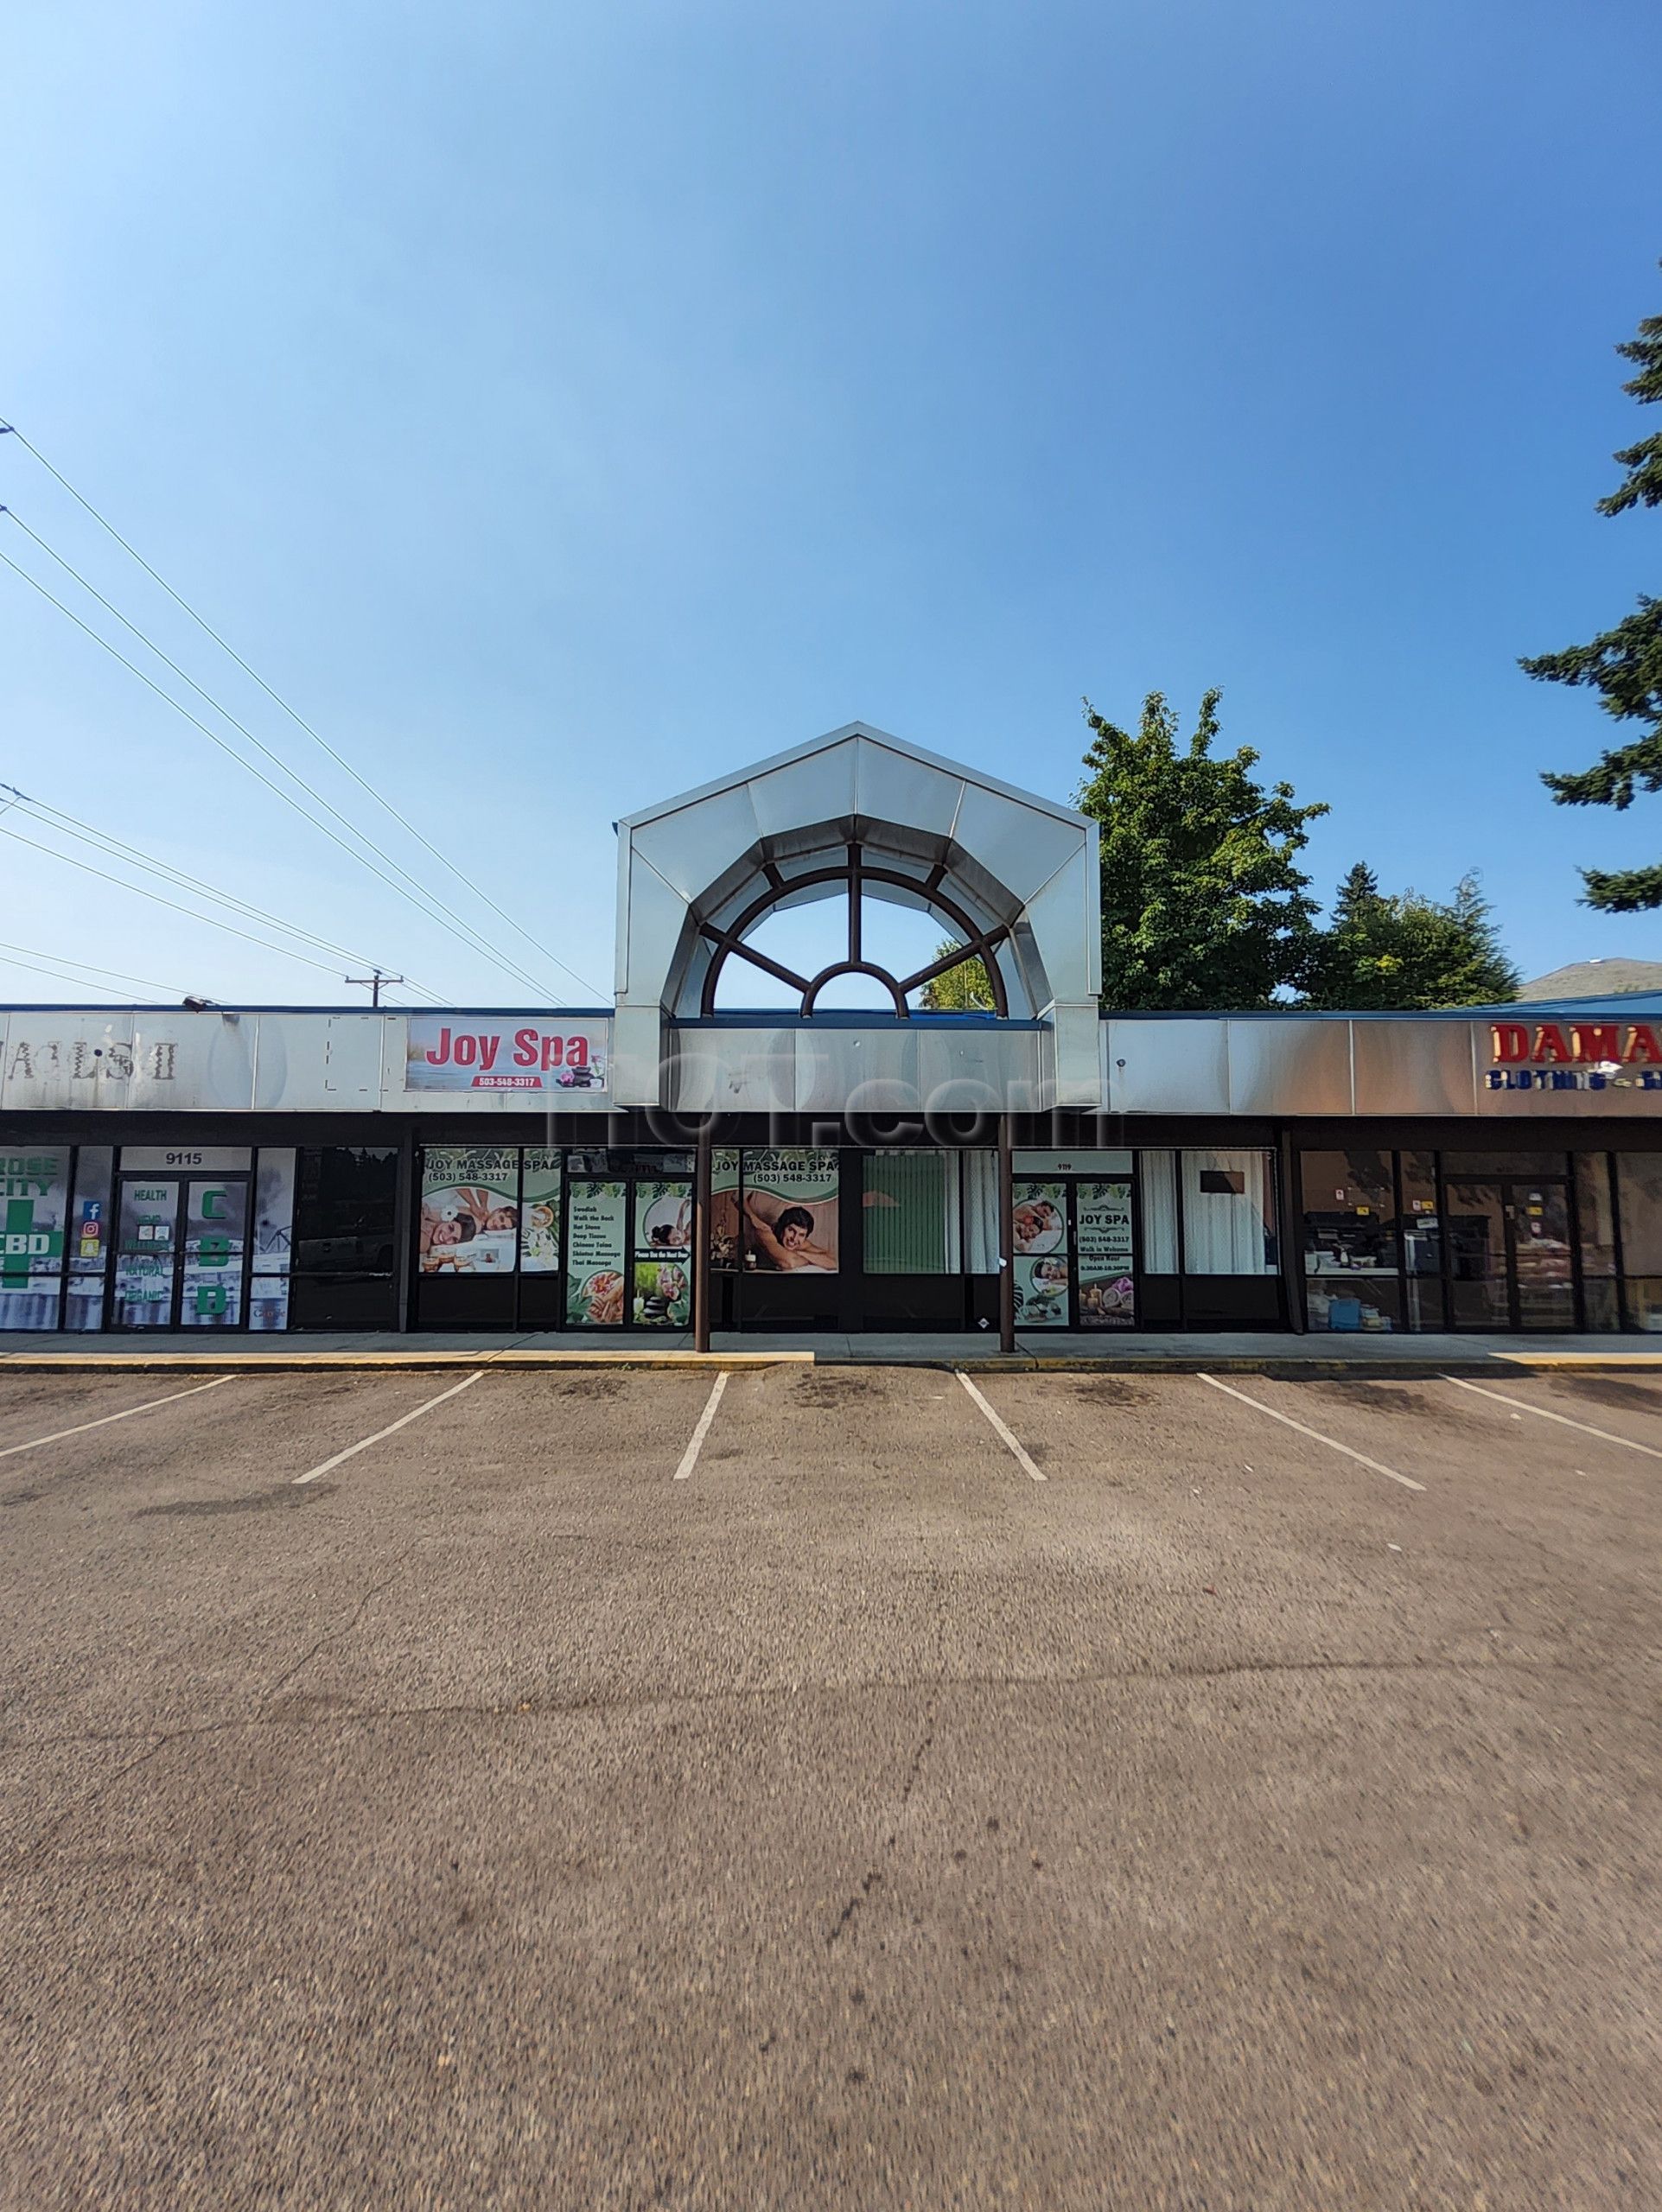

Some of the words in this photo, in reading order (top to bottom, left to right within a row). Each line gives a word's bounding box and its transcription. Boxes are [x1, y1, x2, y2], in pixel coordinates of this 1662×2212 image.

[1490, 1023, 1662, 1063] DAMA
[426, 1028, 501, 1071] Joy
[513, 1028, 589, 1071] Spa
[478, 1077, 535, 1087] 503-548-3317
[166, 1152, 202, 1165] 9115
[429, 1160, 453, 1170] JOY
[456, 1160, 519, 1170] MASSAGE
[524, 1160, 550, 1170] SPA
[715, 1160, 738, 1171] JOY
[743, 1160, 806, 1171] MASSAGE
[809, 1160, 835, 1171] SPA
[429, 1173, 455, 1182] (503)
[458, 1173, 508, 1181] 548-3317
[754, 1173, 780, 1183] (503)
[783, 1173, 831, 1182] 548-3317
[134, 1189, 168, 1201] HEALTH
[1079, 1215, 1102, 1224] JOY
[1105, 1215, 1130, 1224] SPA
[0, 1234, 50, 1255] BD
